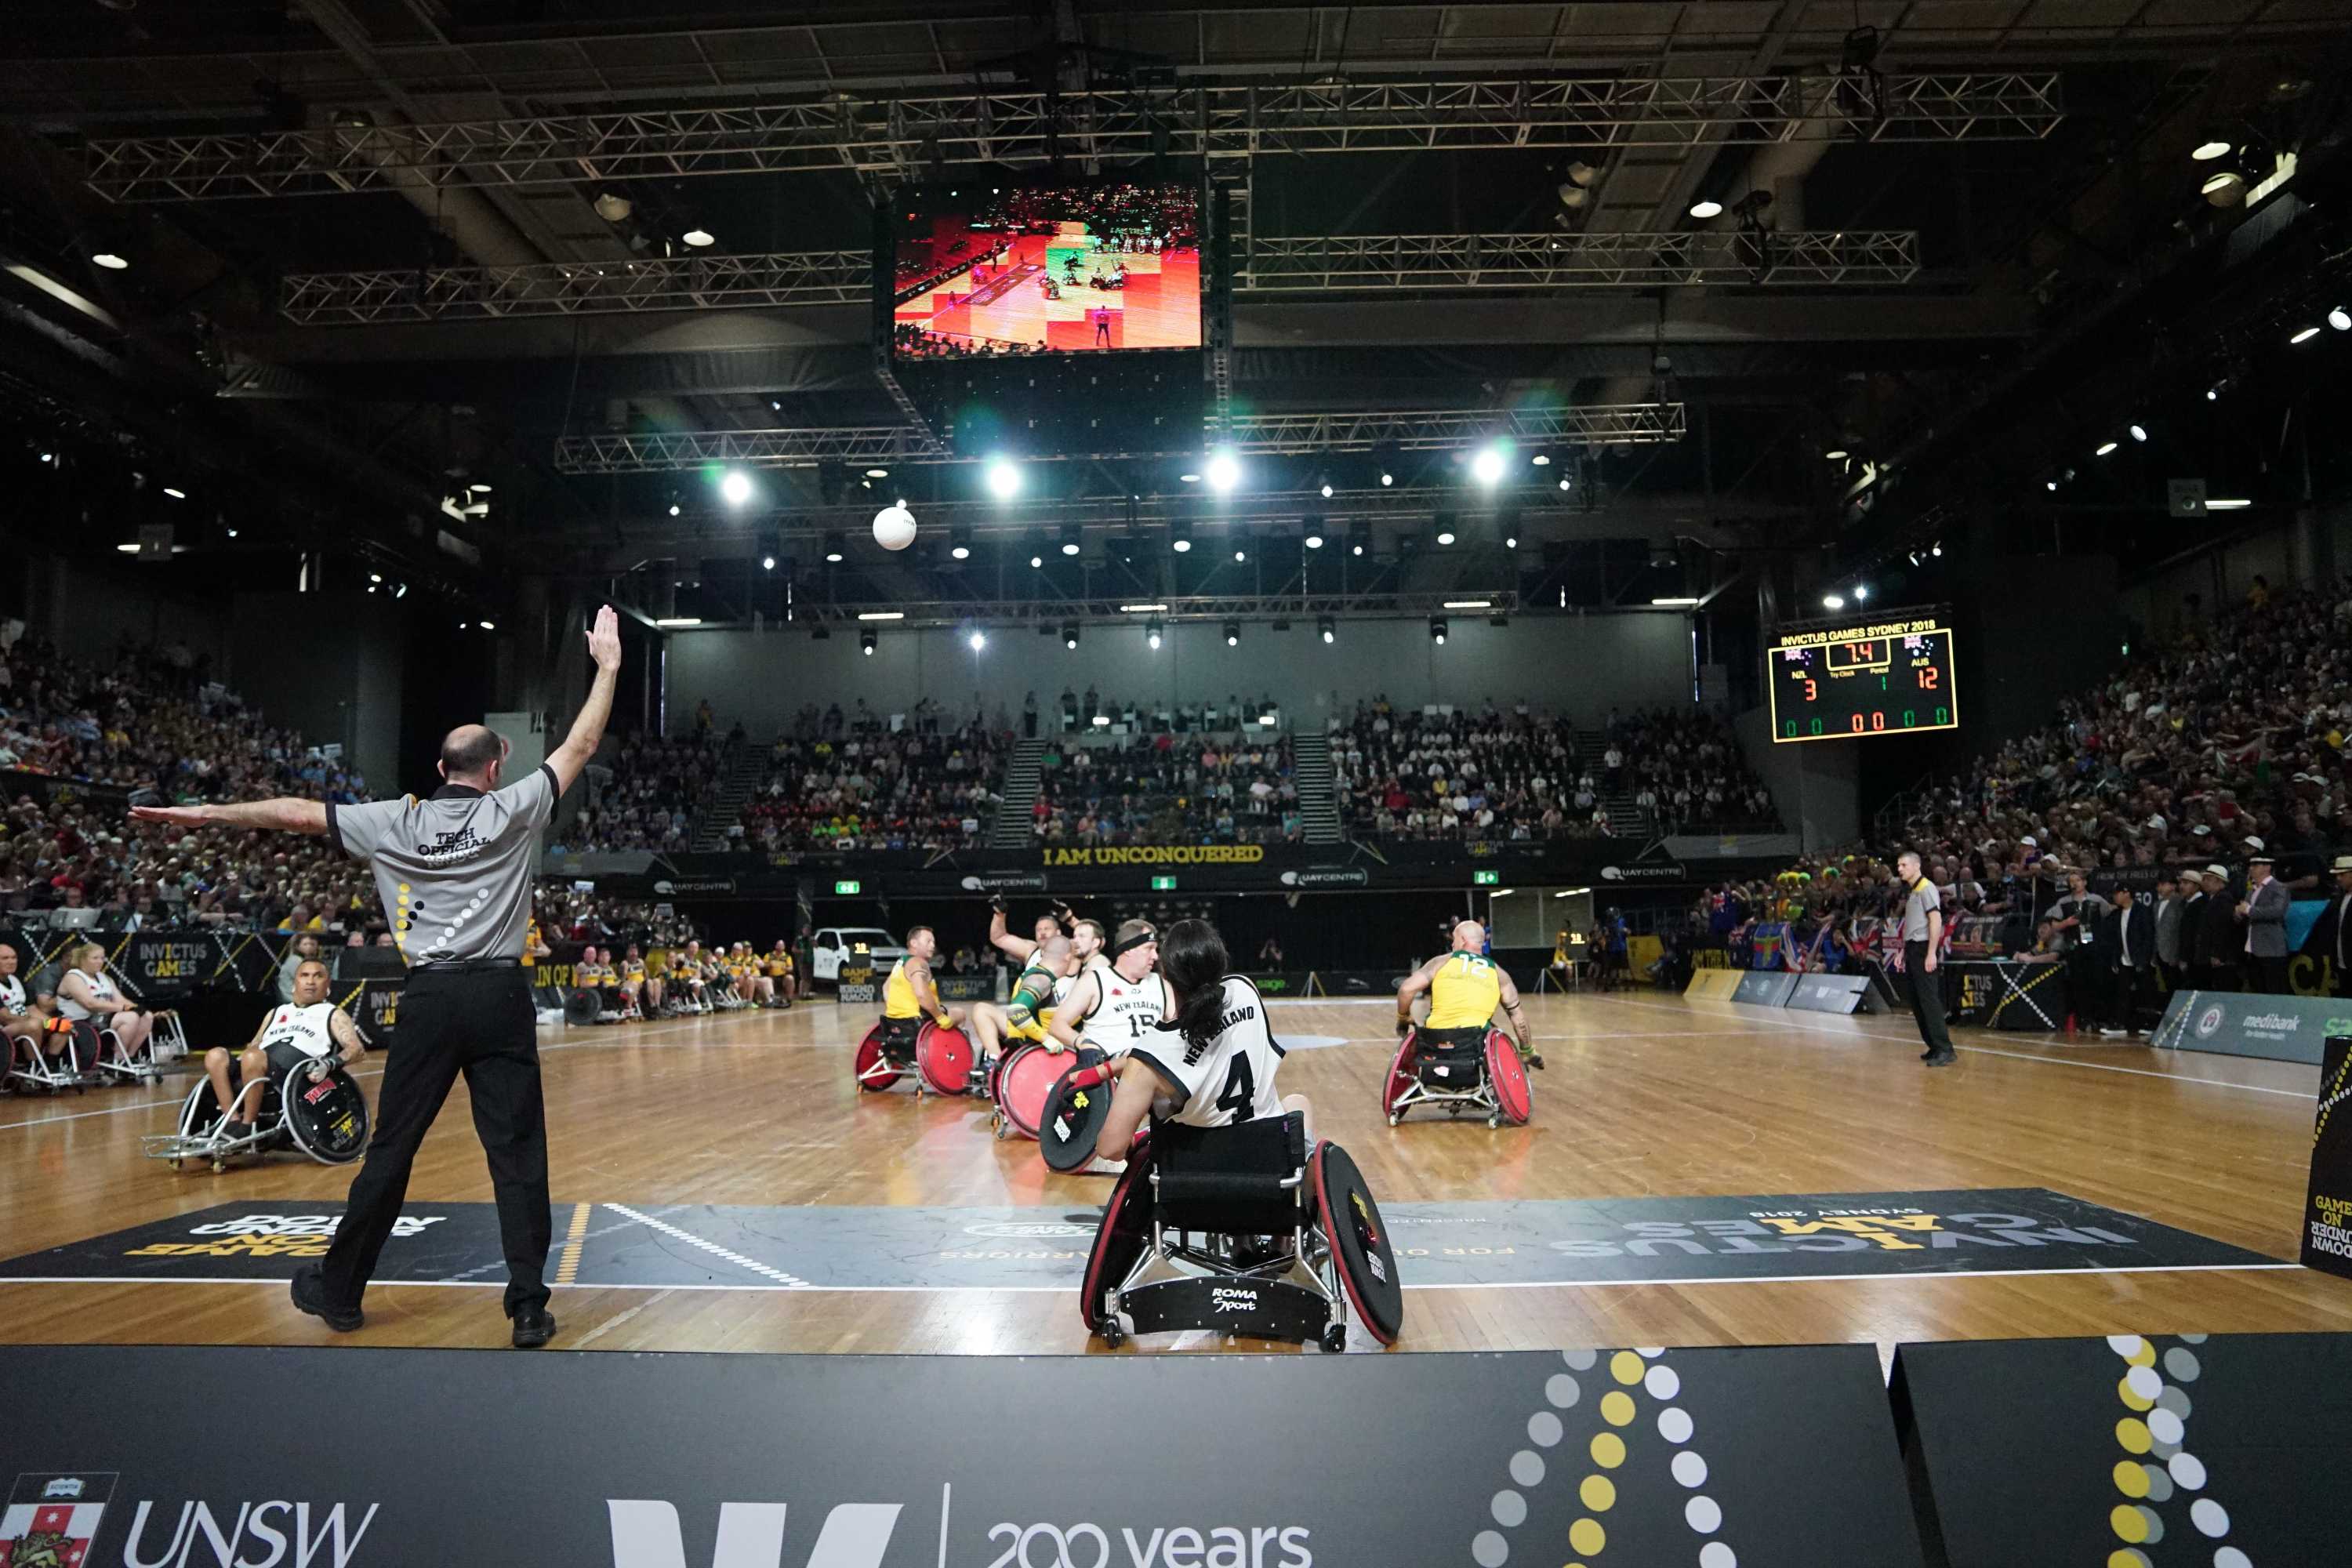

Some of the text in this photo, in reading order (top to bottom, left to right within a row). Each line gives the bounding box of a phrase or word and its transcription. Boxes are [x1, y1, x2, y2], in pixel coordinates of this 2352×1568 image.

[1781, 619, 1936, 647] INVICTUS GAMES SYDNEY 2018
[1845, 642, 1873, 663] 7.4
[1911, 657, 1929, 667] AUS
[1791, 670, 1807, 680] NZL
[1918, 666, 1938, 690] 12
[1805, 678, 1817, 702] 3
[418, 837, 492, 856] OFFICIAL
[436, 827, 475, 845] TECH
[1043, 845, 1264, 865] I AM UNCONQUERED
[140, 943, 207, 960] INVICTUS
[145, 960, 197, 978] GAMES
[554, 965, 568, 986] OF
[842, 967, 873, 977] GAME
[1459, 953, 1489, 978] 12
[1113, 1002, 1131, 1013] NEW
[1127, 1014, 1156, 1037] 15
[2242, 1013, 2299, 1031] medibank
[1182, 1036, 1209, 1067] NEW
[1215, 1049, 1255, 1123] 4
[1818, 1208, 1924, 1217] SYDNEY
[2315, 1195, 2352, 1216] GAME
[223, 1214, 448, 1227] DON
[1622, 1213, 2038, 1238] GAMES
[2322, 1210, 2343, 1227] ON
[1548, 1226, 2139, 1256] INVICTUS
[2311, 1221, 2352, 1244] UNDER
[2312, 1236, 2352, 1259] DOWN
[1212, 1288, 1258, 1300] ROMA
[1213, 1297, 1256, 1313] Sport
[123, 1500, 380, 1568] UNSW
[988, 1523, 1312, 1568] 200 years
